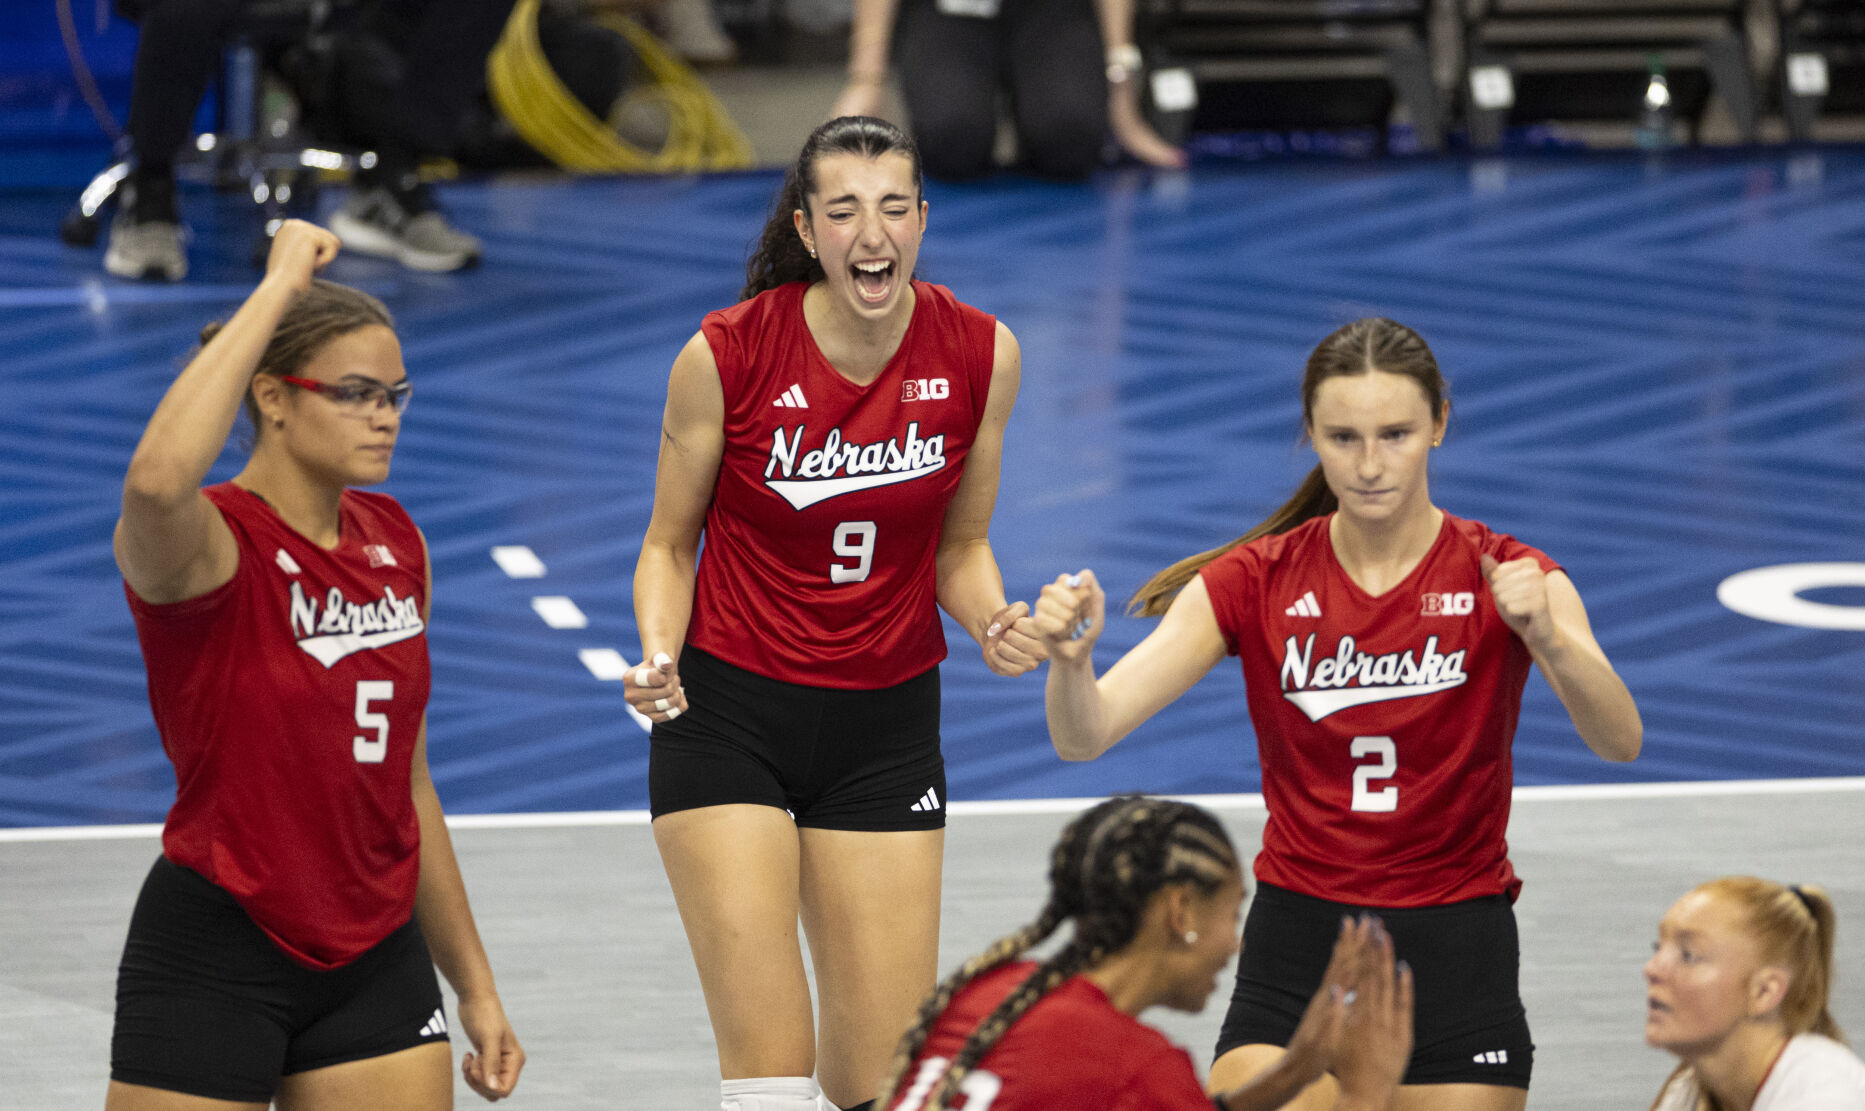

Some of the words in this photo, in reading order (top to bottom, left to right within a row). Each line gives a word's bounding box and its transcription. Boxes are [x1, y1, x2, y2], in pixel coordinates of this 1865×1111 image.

[764, 421, 946, 480] Nebraska
[830, 520, 877, 584] 9
[289, 580, 425, 638] Nebraska
[1280, 631, 1468, 691] Nebraska
[352, 680, 394, 764] 5
[1350, 735, 1399, 812] 2
